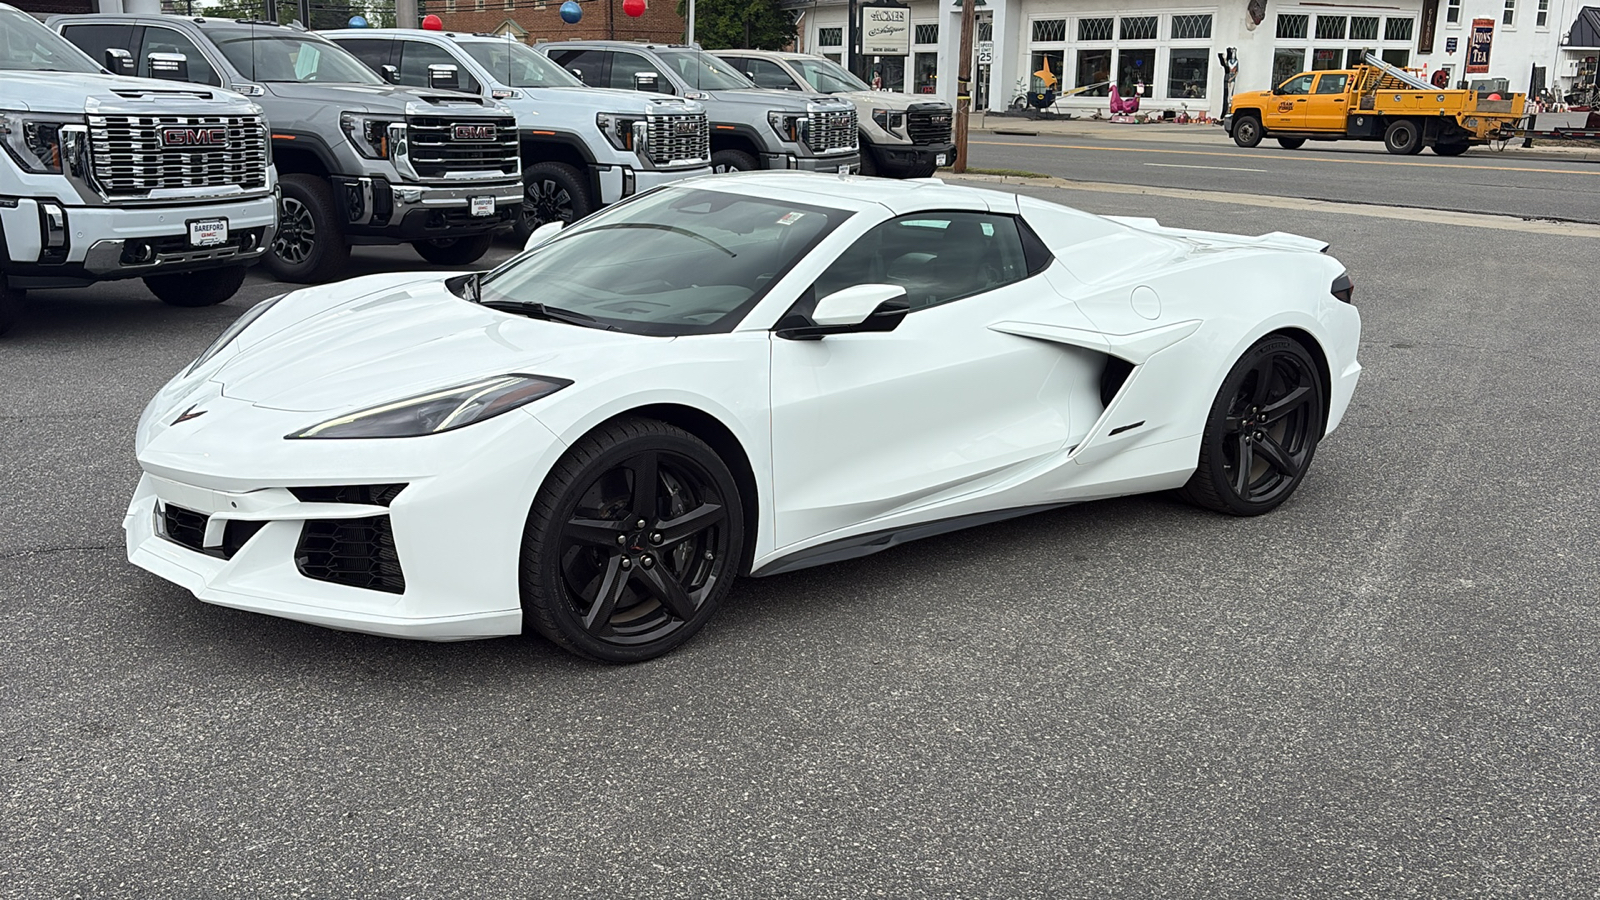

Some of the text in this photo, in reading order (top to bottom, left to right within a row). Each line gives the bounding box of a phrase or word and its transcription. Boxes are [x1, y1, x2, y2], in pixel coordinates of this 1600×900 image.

[870, 10, 905, 22] ACME
[980, 52, 992, 62] 25
[1472, 49, 1487, 63] TEA
[163, 128, 227, 145] GMC
[455, 126, 496, 138] GMC
[194, 223, 224, 232] BAREFORD
